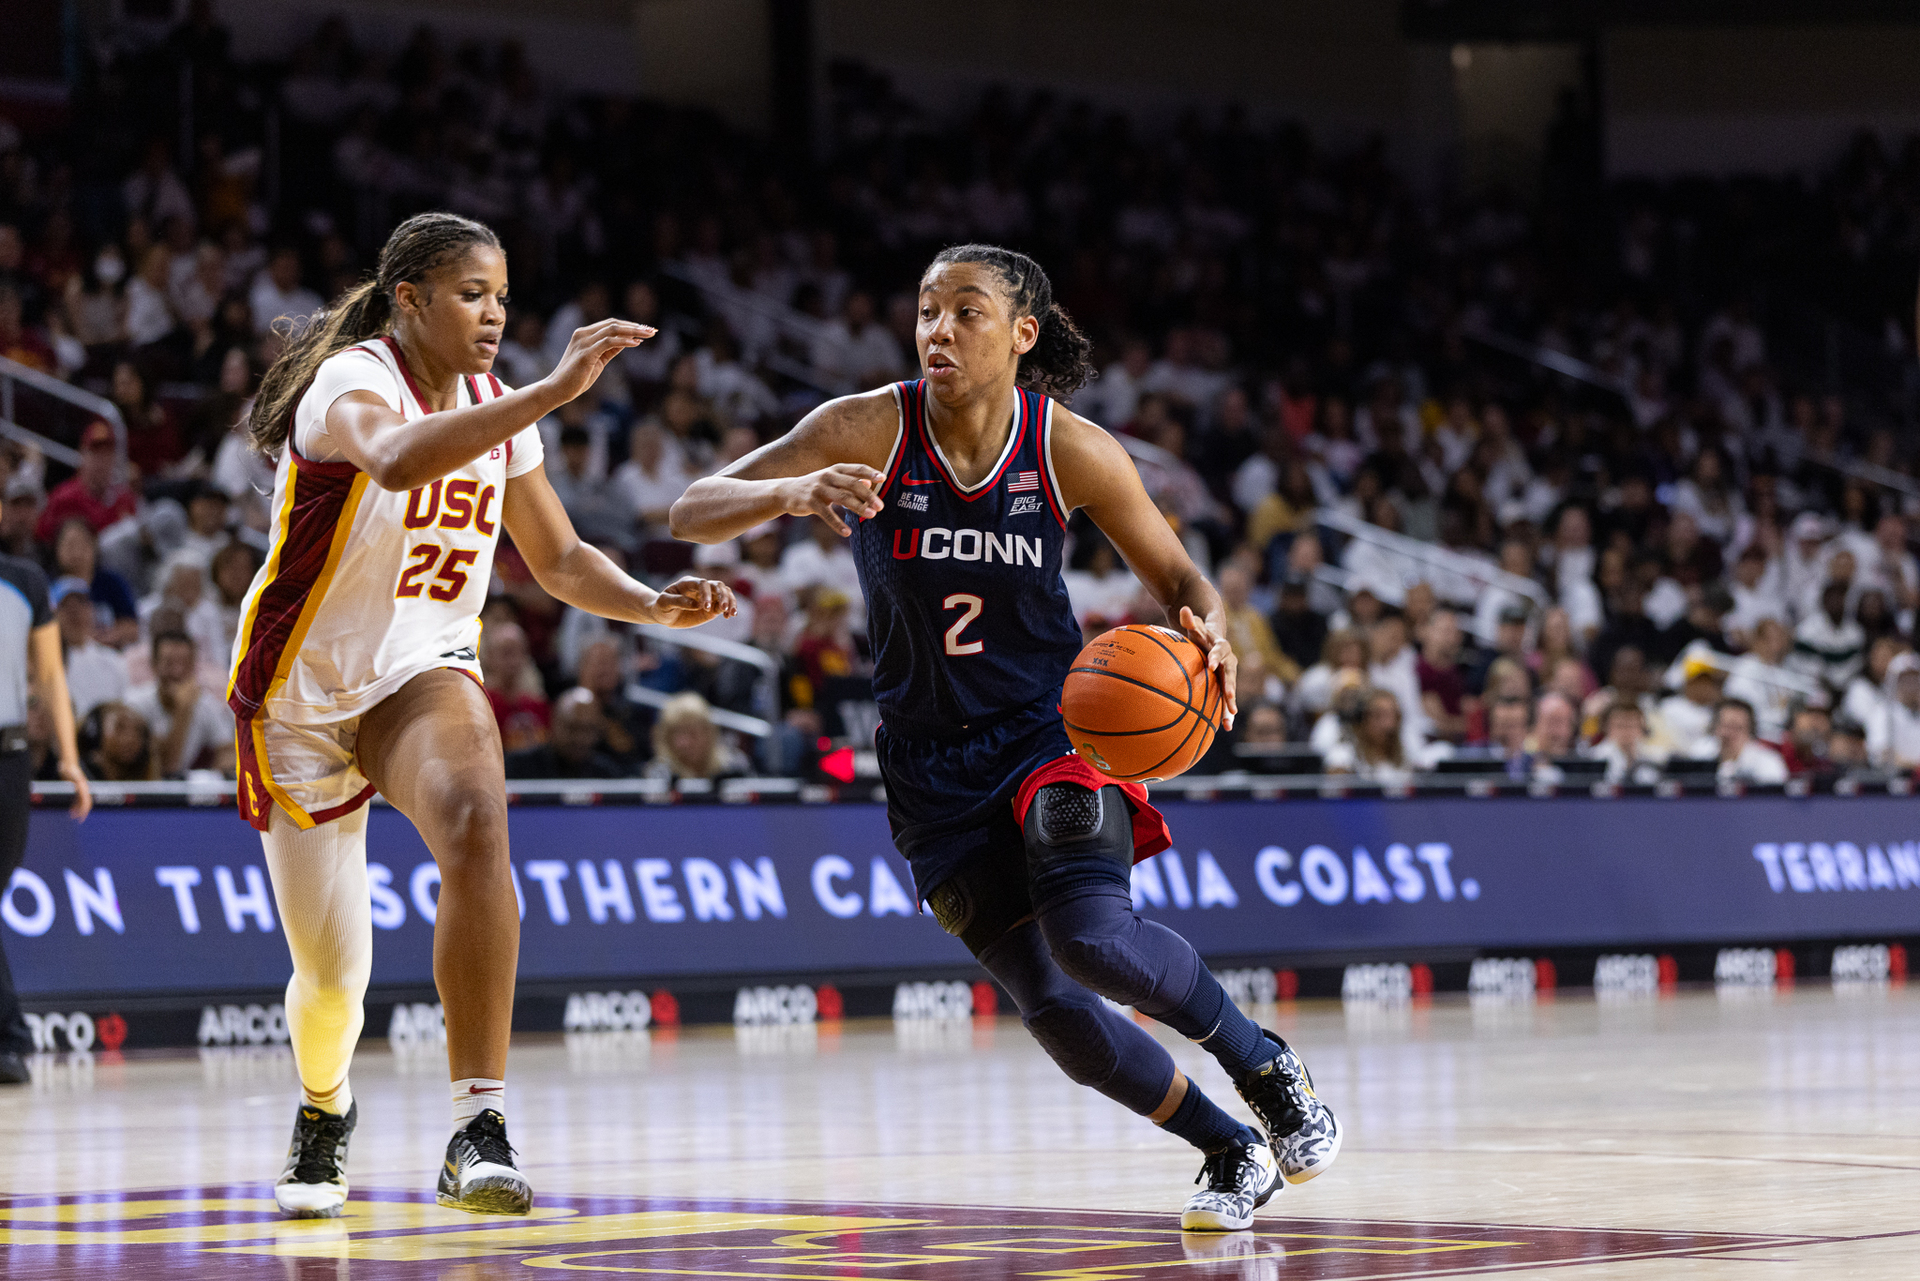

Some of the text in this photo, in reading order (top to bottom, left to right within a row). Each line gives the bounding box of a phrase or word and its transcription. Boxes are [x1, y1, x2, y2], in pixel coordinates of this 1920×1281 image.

[402, 477, 495, 538] USC
[897, 499, 929, 512] CHANGE
[900, 492, 929, 504] BE THE
[1010, 502, 1043, 513] EAST
[1013, 496, 1037, 505] BIG
[892, 527, 1042, 568] UCONN
[394, 542, 480, 603] 25
[942, 593, 985, 656] 2
[0, 866, 126, 937] ON
[154, 864, 277, 935] TH
[366, 855, 788, 931] SOTHERN
[1254, 842, 1481, 907] COAST.
